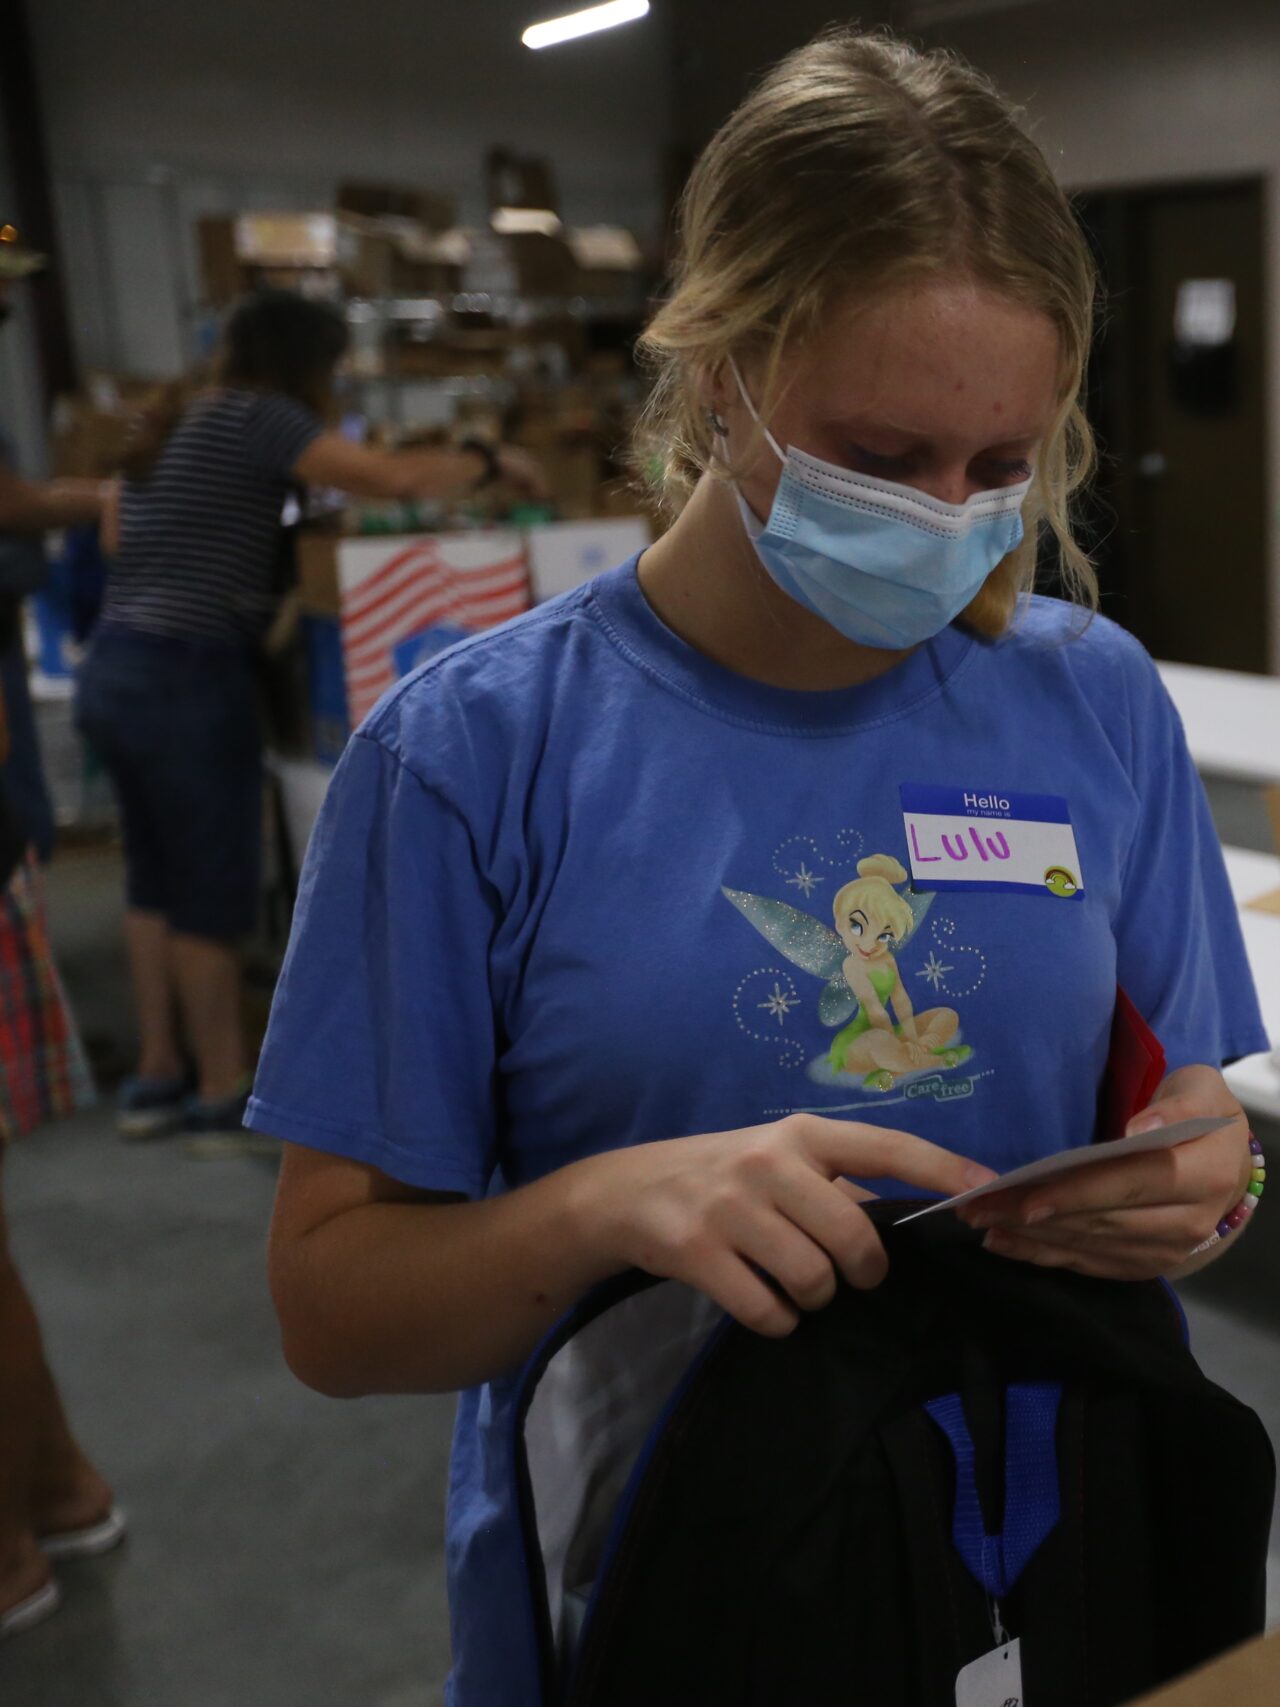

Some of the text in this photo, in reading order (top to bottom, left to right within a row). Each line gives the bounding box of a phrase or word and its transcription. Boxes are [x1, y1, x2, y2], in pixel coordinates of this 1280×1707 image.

[963, 792, 1010, 810] Hello
[966, 809, 979, 817] my
[980, 809, 1002, 817] name
[910, 823, 1011, 862] Lulu
